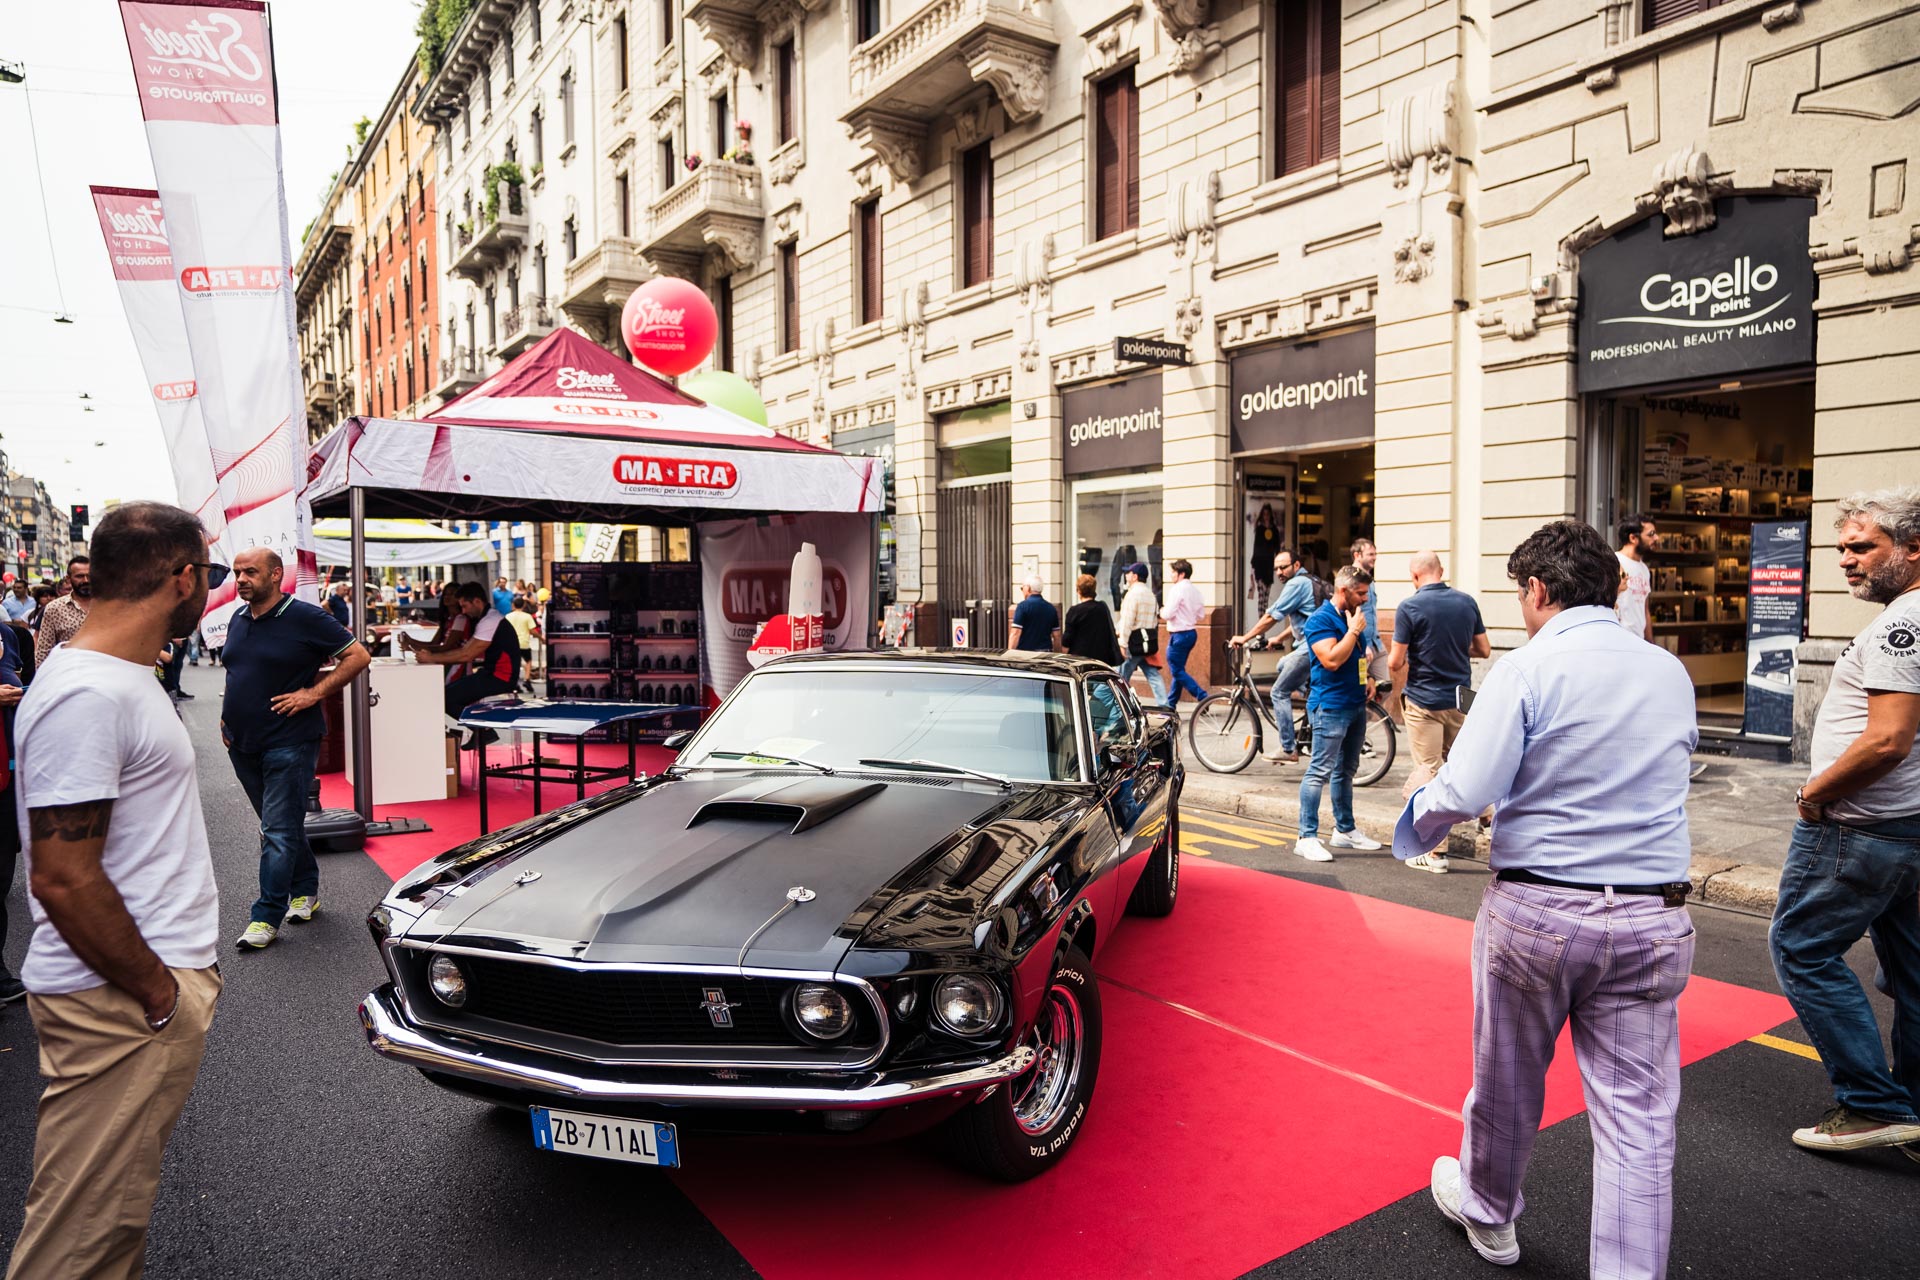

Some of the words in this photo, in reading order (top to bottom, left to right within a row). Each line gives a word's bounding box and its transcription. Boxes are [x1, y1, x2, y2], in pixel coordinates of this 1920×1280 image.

[1639, 255, 1779, 317] Capello
[631, 297, 686, 336] Street
[1709, 294, 1752, 319] point
[655, 329, 685, 338] SHOW
[1589, 339, 1679, 362] PROFESSIONAL
[1683, 328, 1735, 348] BEAUTY
[1738, 316, 1797, 339] MILANO
[1122, 341, 1181, 361] goldenpoint
[556, 366, 616, 389] Street
[1239, 368, 1368, 421] goldenpoint
[1069, 405, 1162, 447] goldenpoint
[663, 488, 676, 496] per
[708, 489, 725, 497] auto
[1753, 571, 1779, 580] BEAUTY
[1779, 571, 1801, 580] CLUB!
[823, 632, 836, 645] uto
[1893, 632, 1909, 645] 72
[1879, 643, 1919, 658] MOLVENA
[1050, 1102, 1086, 1154] Radial
